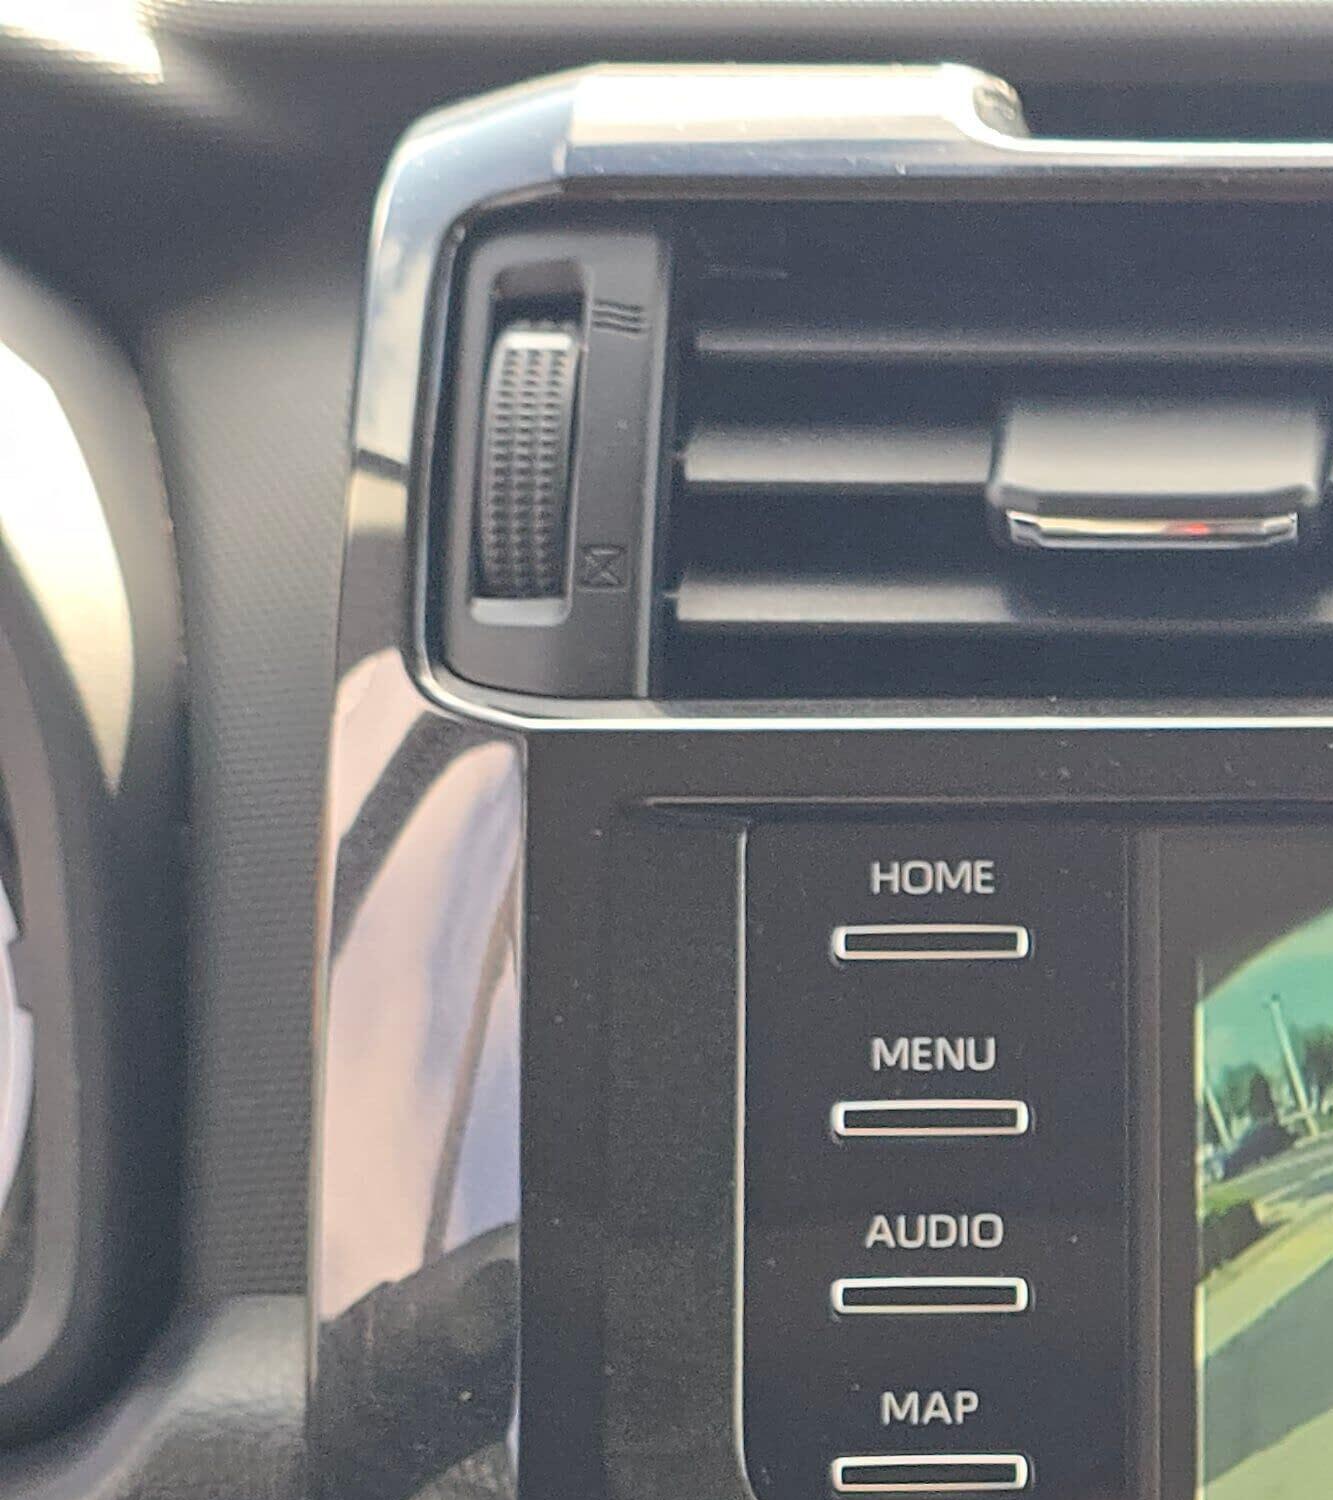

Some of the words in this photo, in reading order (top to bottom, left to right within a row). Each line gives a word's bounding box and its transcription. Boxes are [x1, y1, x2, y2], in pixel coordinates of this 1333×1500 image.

[870, 860, 996, 894] HOME
[871, 1036, 997, 1072] MENU
[865, 1213, 1005, 1249] AUDIO
[880, 1389, 980, 1425] MAP
